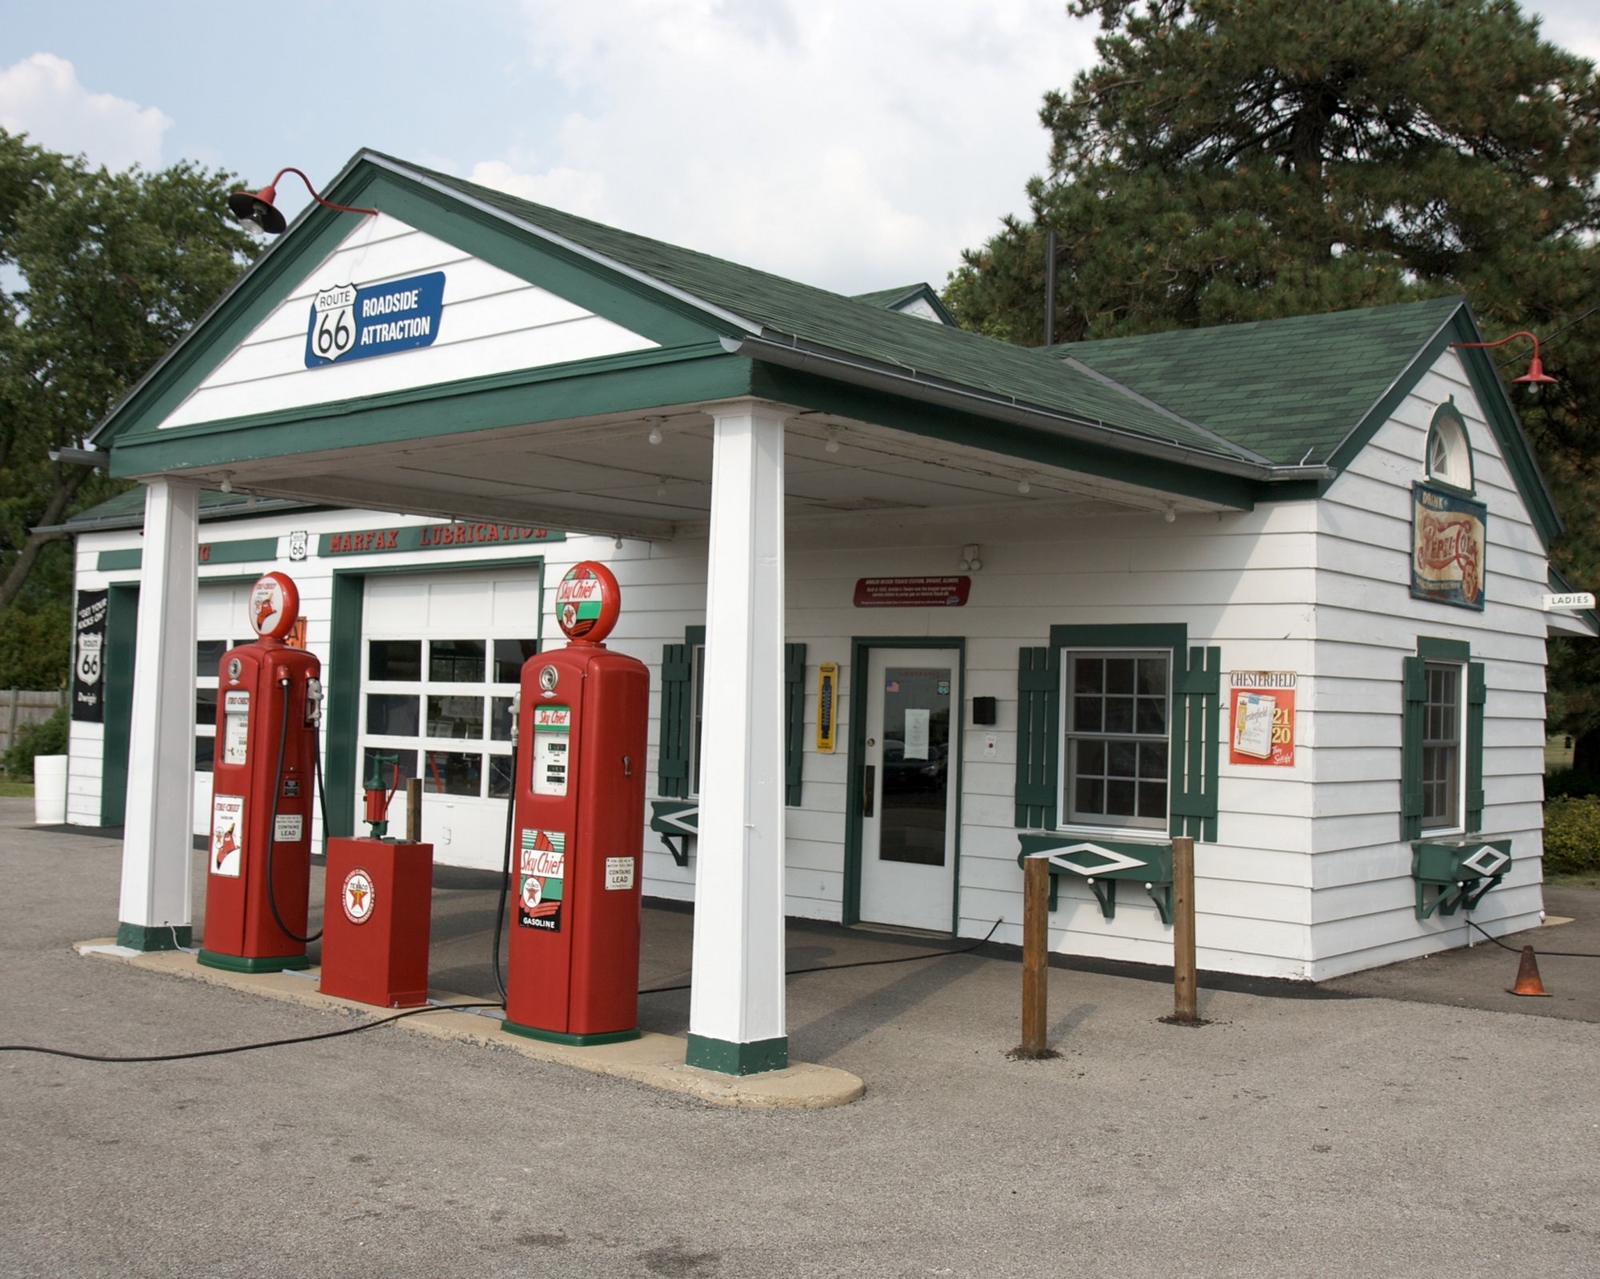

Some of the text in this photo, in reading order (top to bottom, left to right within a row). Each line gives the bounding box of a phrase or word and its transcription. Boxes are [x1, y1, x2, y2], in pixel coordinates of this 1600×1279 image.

[320, 290, 351, 308] ROUTE
[362, 289, 419, 318] ROADSIDE
[318, 309, 350, 354] 66
[360, 316, 431, 346] ATTRACTION
[292, 541, 304, 555] 66
[330, 530, 398, 553] MARFAX
[559, 579, 598, 602] Sky Chief
[1551, 595, 1589, 605] LADIES
[78, 616, 94, 630] KICKS
[82, 654, 98, 675] 66
[1230, 672, 1296, 688] CHESTERFIELD
[539, 710, 568, 725] Sky Chief
[1272, 708, 1289, 725] 21
[1272, 727, 1291, 744] 20
[521, 850, 565, 876] Sky Chief
[523, 917, 555, 929] GASOLINE
